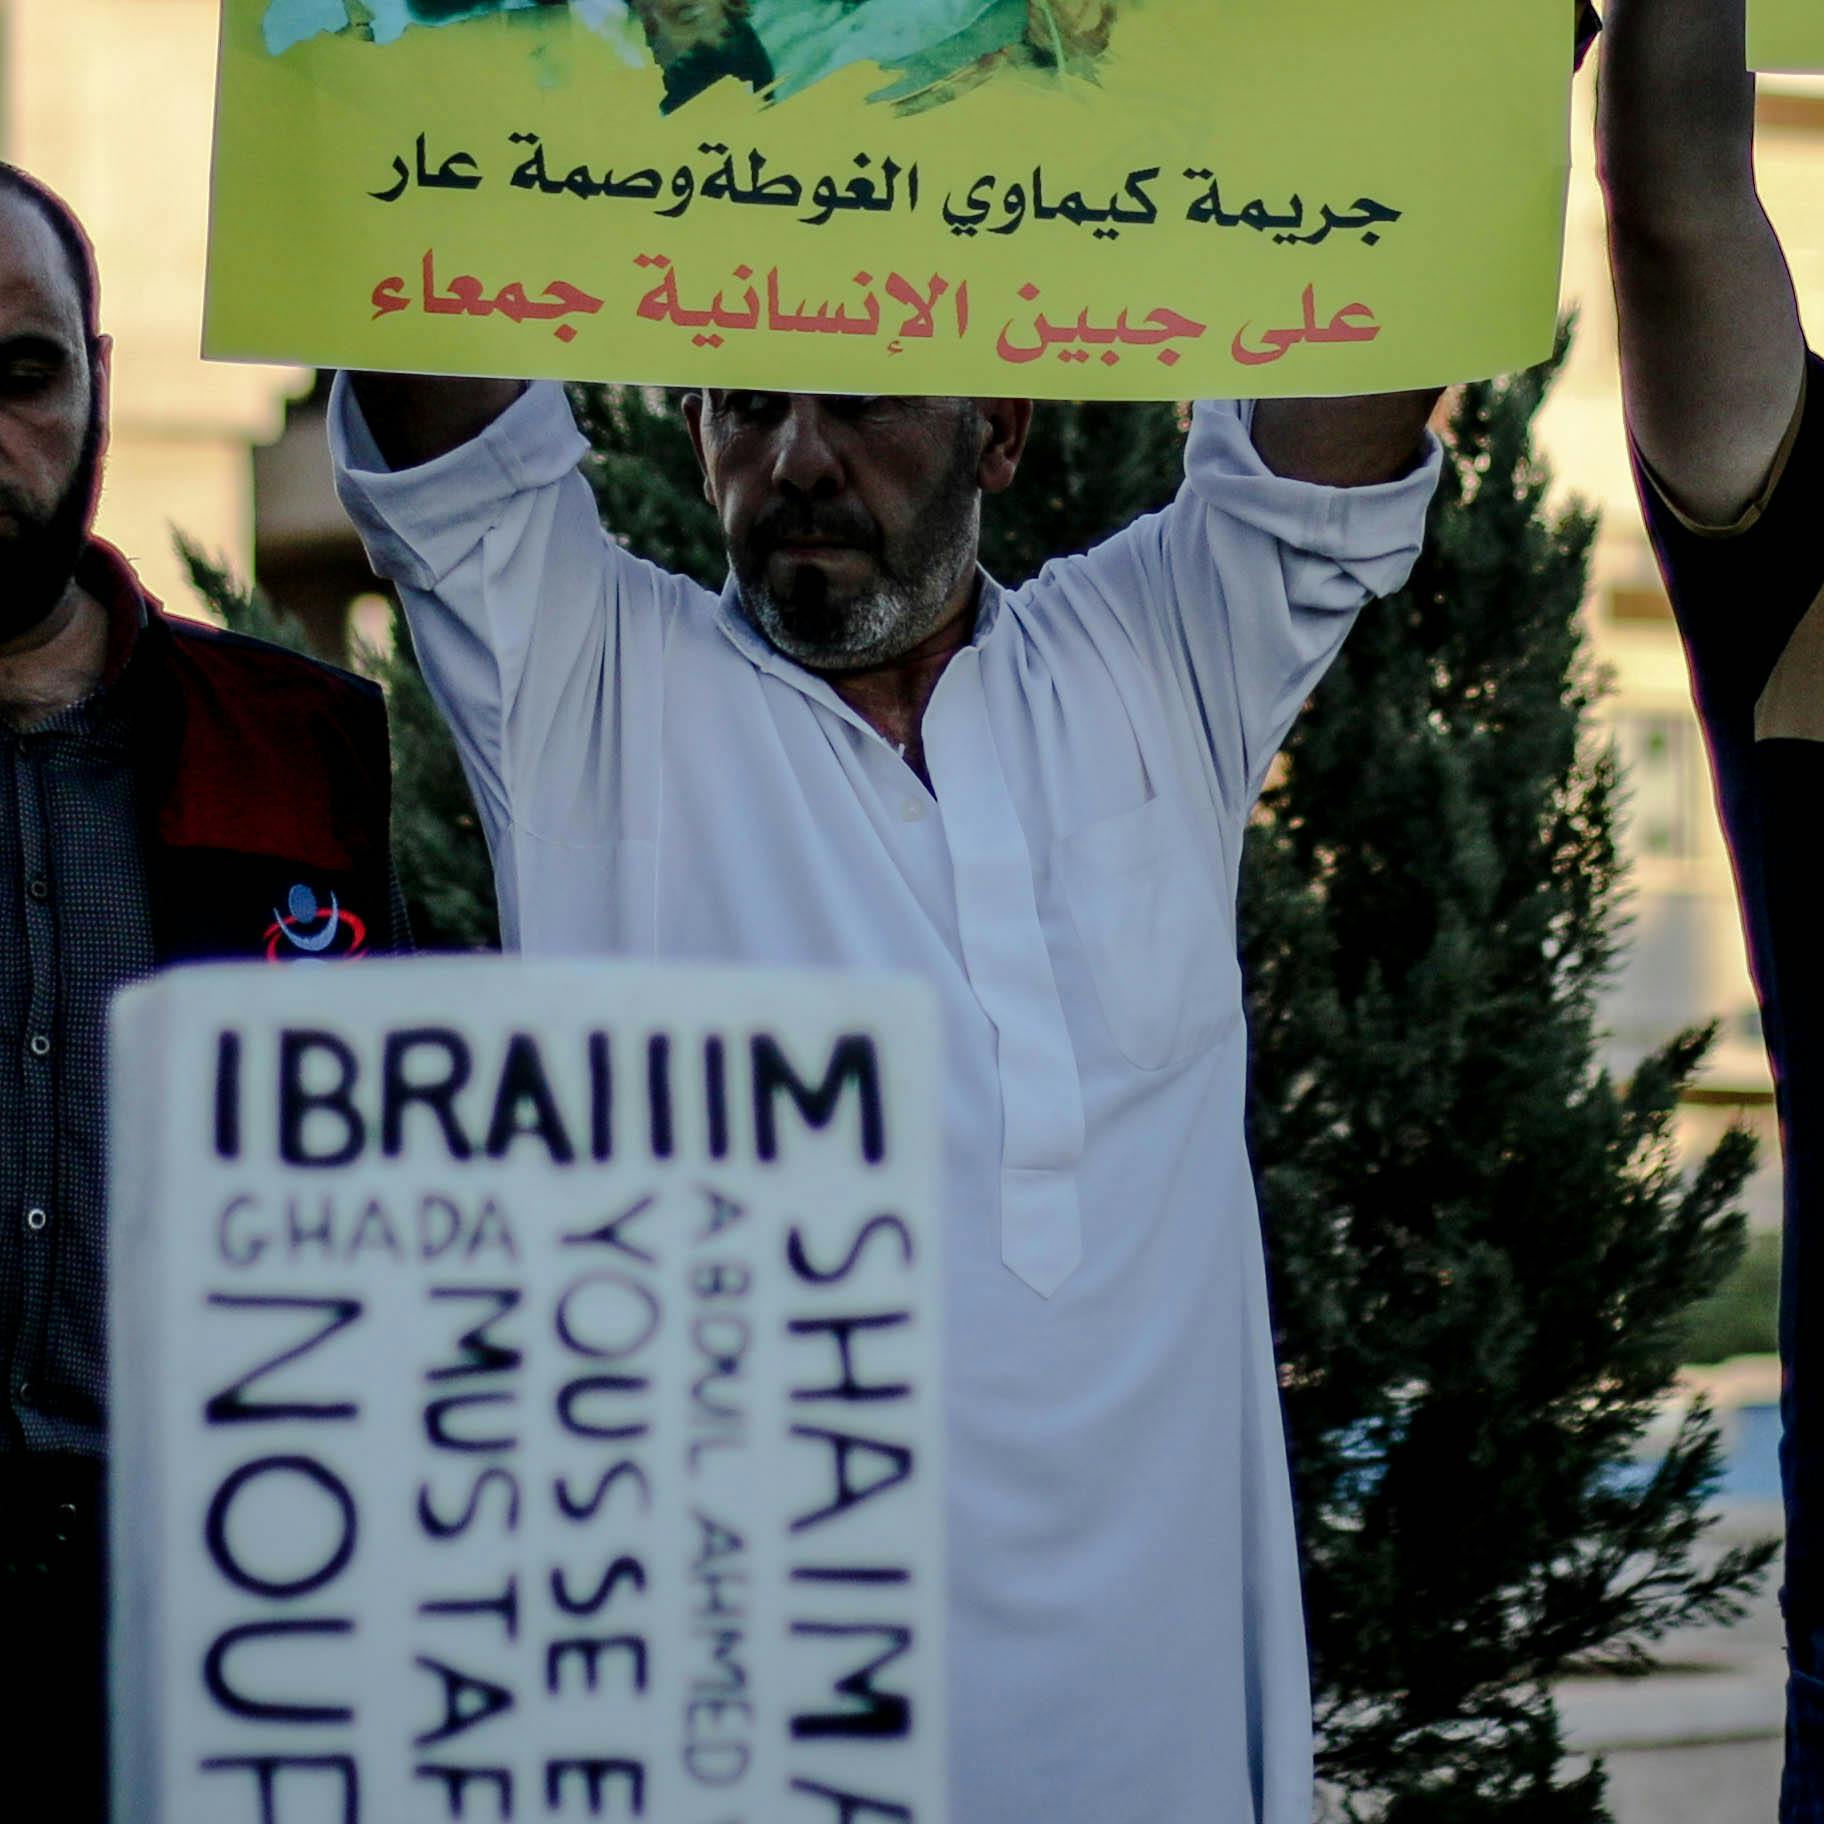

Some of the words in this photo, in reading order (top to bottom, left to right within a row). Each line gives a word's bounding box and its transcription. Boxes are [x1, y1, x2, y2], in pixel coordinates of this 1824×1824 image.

[366, 130, 484, 203] عار
[941, 164, 1162, 241] كيماوي
[1181, 167, 1404, 248] جريمة
[371, 250, 604, 336] جمعاء
[633, 254, 969, 355] الإنسانية
[996, 283, 1207, 366] جبين
[1231, 284, 1380, 366] على
[215, 1191, 518, 1270] GHADA
